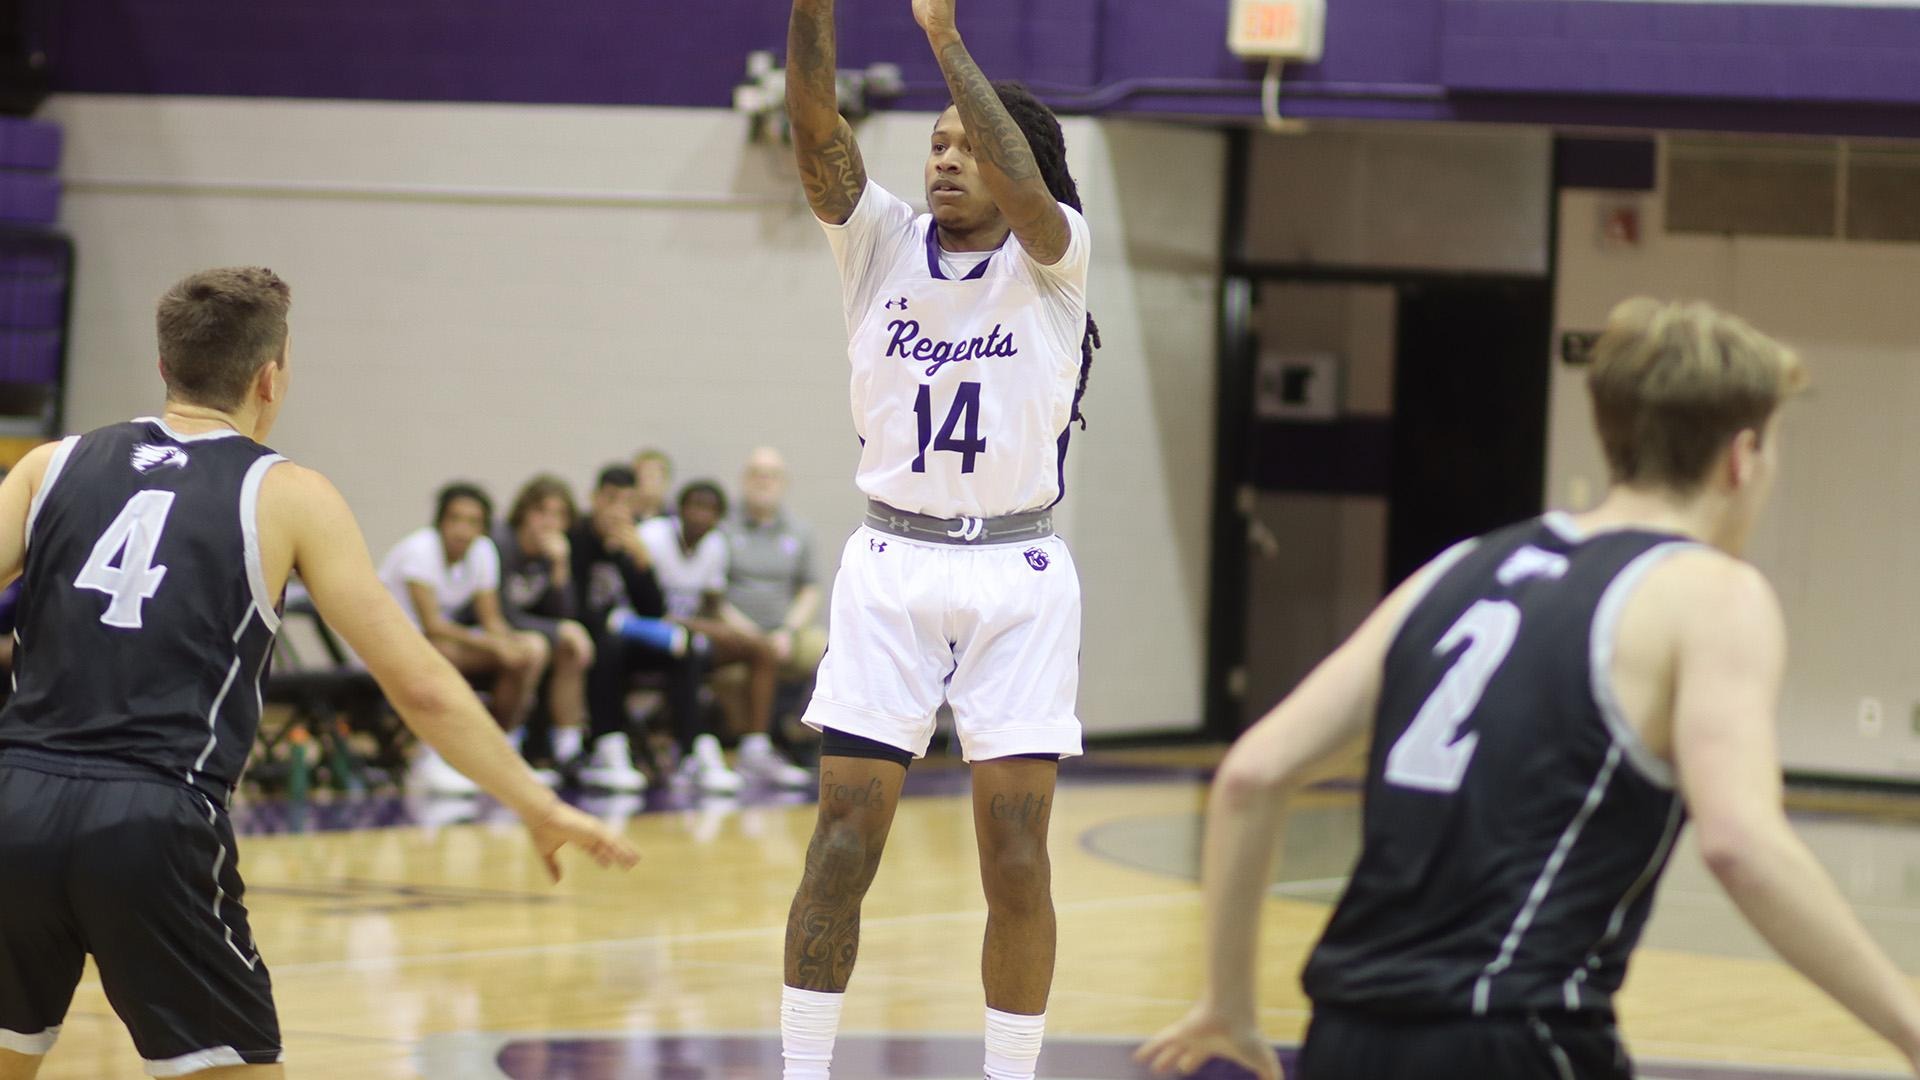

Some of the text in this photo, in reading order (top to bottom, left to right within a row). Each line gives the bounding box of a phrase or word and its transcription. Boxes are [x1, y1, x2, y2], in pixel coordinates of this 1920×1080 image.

[885, 319, 1018, 377] Regents
[911, 381, 987, 474] 14
[73, 489, 176, 629] 4
[1384, 600, 1521, 793] 2
